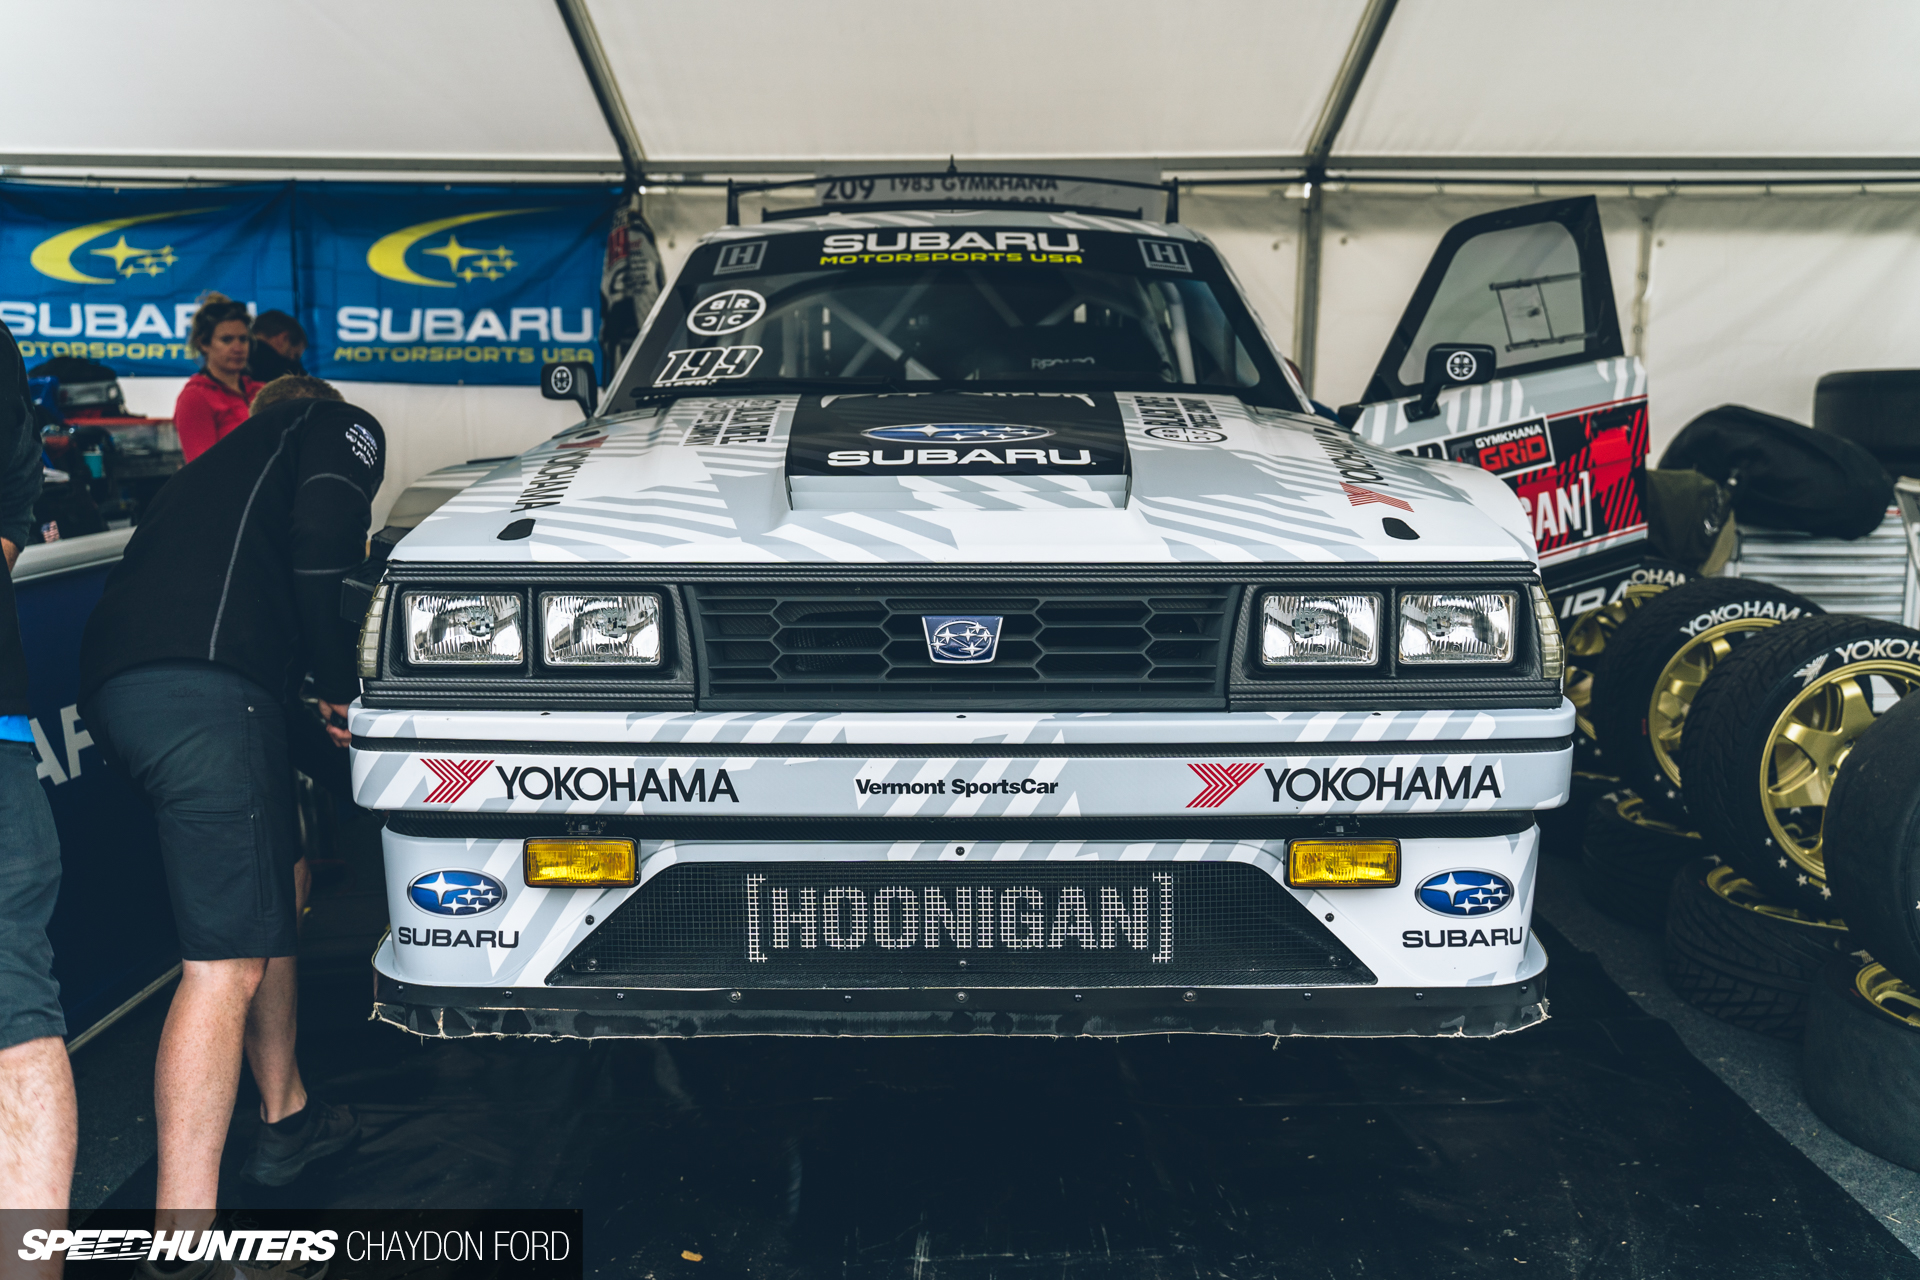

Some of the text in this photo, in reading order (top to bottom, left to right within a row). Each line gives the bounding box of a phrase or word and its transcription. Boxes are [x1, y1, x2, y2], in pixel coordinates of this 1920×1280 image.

[823, 176, 1059, 201] 209 1983 GYMKHANA
[823, 231, 1084, 253] SUBARU
[820, 252, 1082, 265] MOTORSPORTS USA
[0, 301, 257, 339] SUBAR
[337, 306, 594, 343] SUBARU
[17, 341, 200, 360] OTORSPORTS
[333, 346, 595, 364] MOTORSPORTS USA
[654, 345, 764, 385] 199
[1475, 424, 1543, 448] GYMKHANA
[827, 449, 1097, 467] SUBARU
[1680, 601, 1812, 638] YOKOHAM
[495, 766, 739, 803] YOKOHAMA
[855, 778, 1058, 798] Vermont SportsCar
[1264, 765, 1502, 803] YOKOHAMA
[398, 926, 520, 949] SUBARU
[1402, 926, 1523, 948] SUBARU
